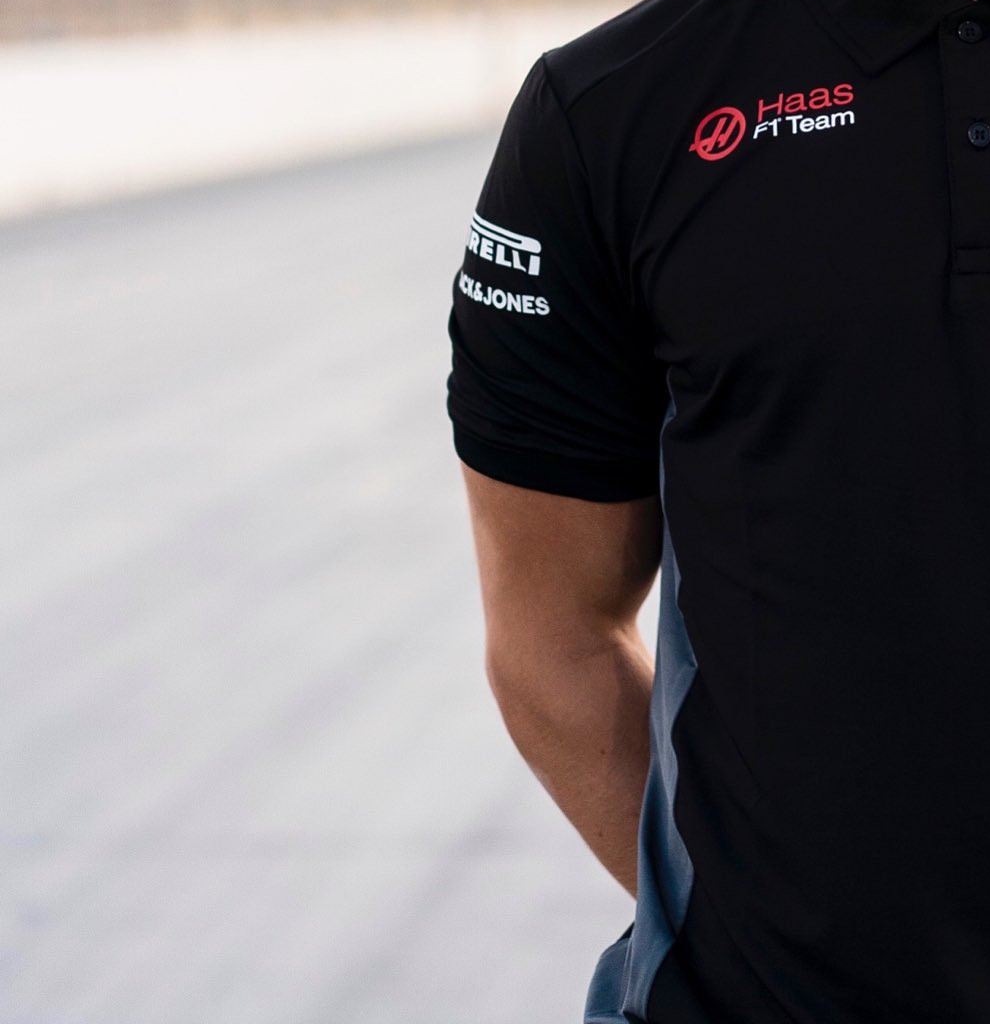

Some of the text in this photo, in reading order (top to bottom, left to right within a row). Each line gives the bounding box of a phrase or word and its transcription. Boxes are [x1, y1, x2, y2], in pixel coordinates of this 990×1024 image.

[758, 83, 855, 122] Haas
[785, 110, 855, 134] Team
[466, 211, 542, 276] RELLI
